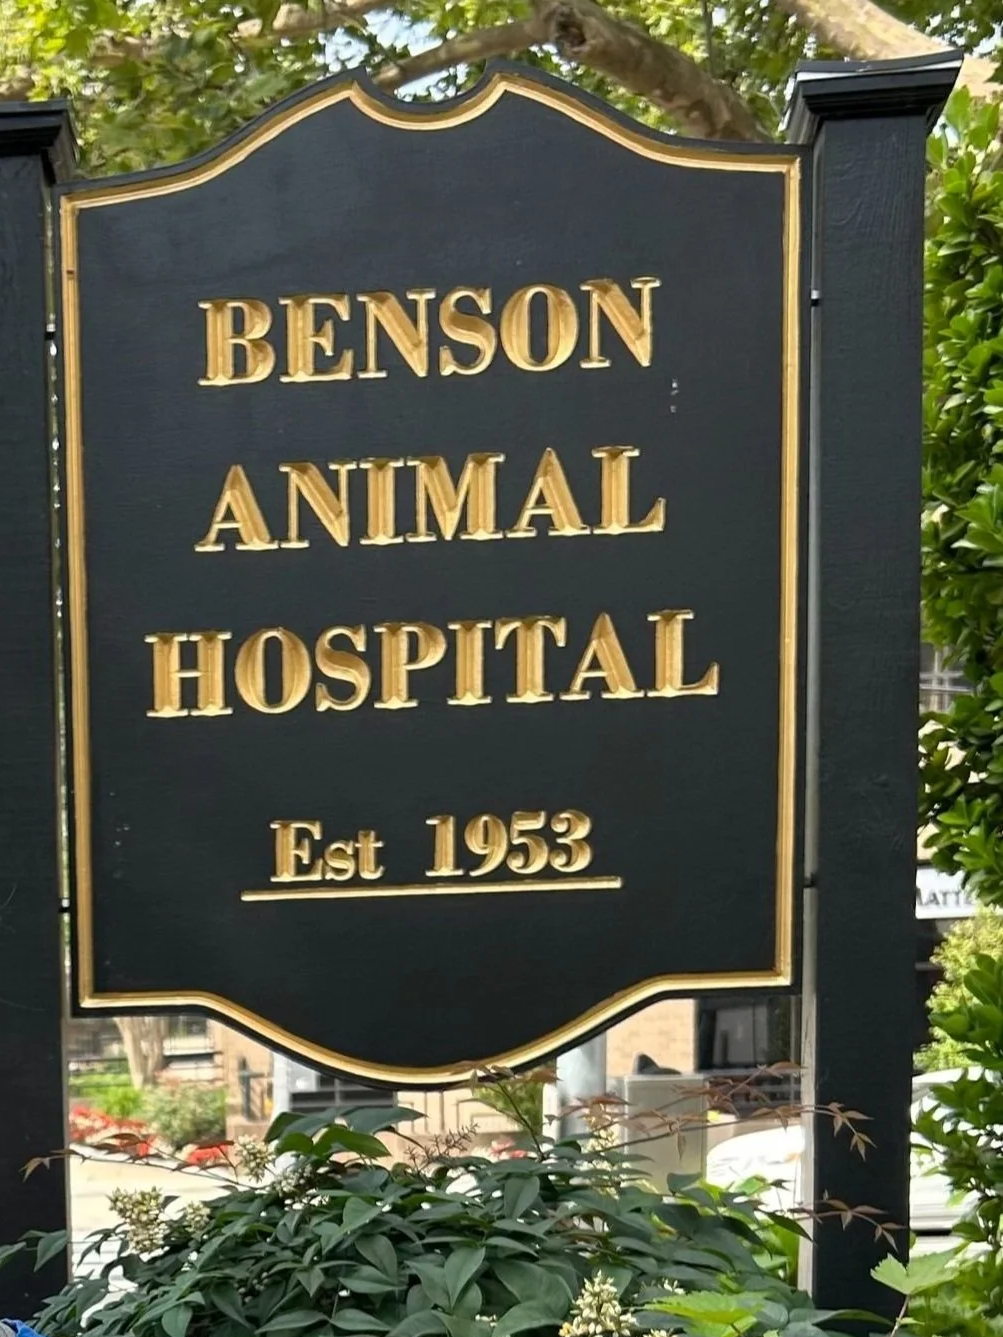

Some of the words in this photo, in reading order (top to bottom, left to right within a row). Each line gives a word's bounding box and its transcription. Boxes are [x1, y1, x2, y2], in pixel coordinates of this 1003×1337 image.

[199, 276, 661, 387] BENSON
[195, 445, 666, 553] ANIMAL
[145, 609, 720, 718] HOSPITAL
[270, 819, 385, 882] Est
[425, 809, 593, 878] 1953
